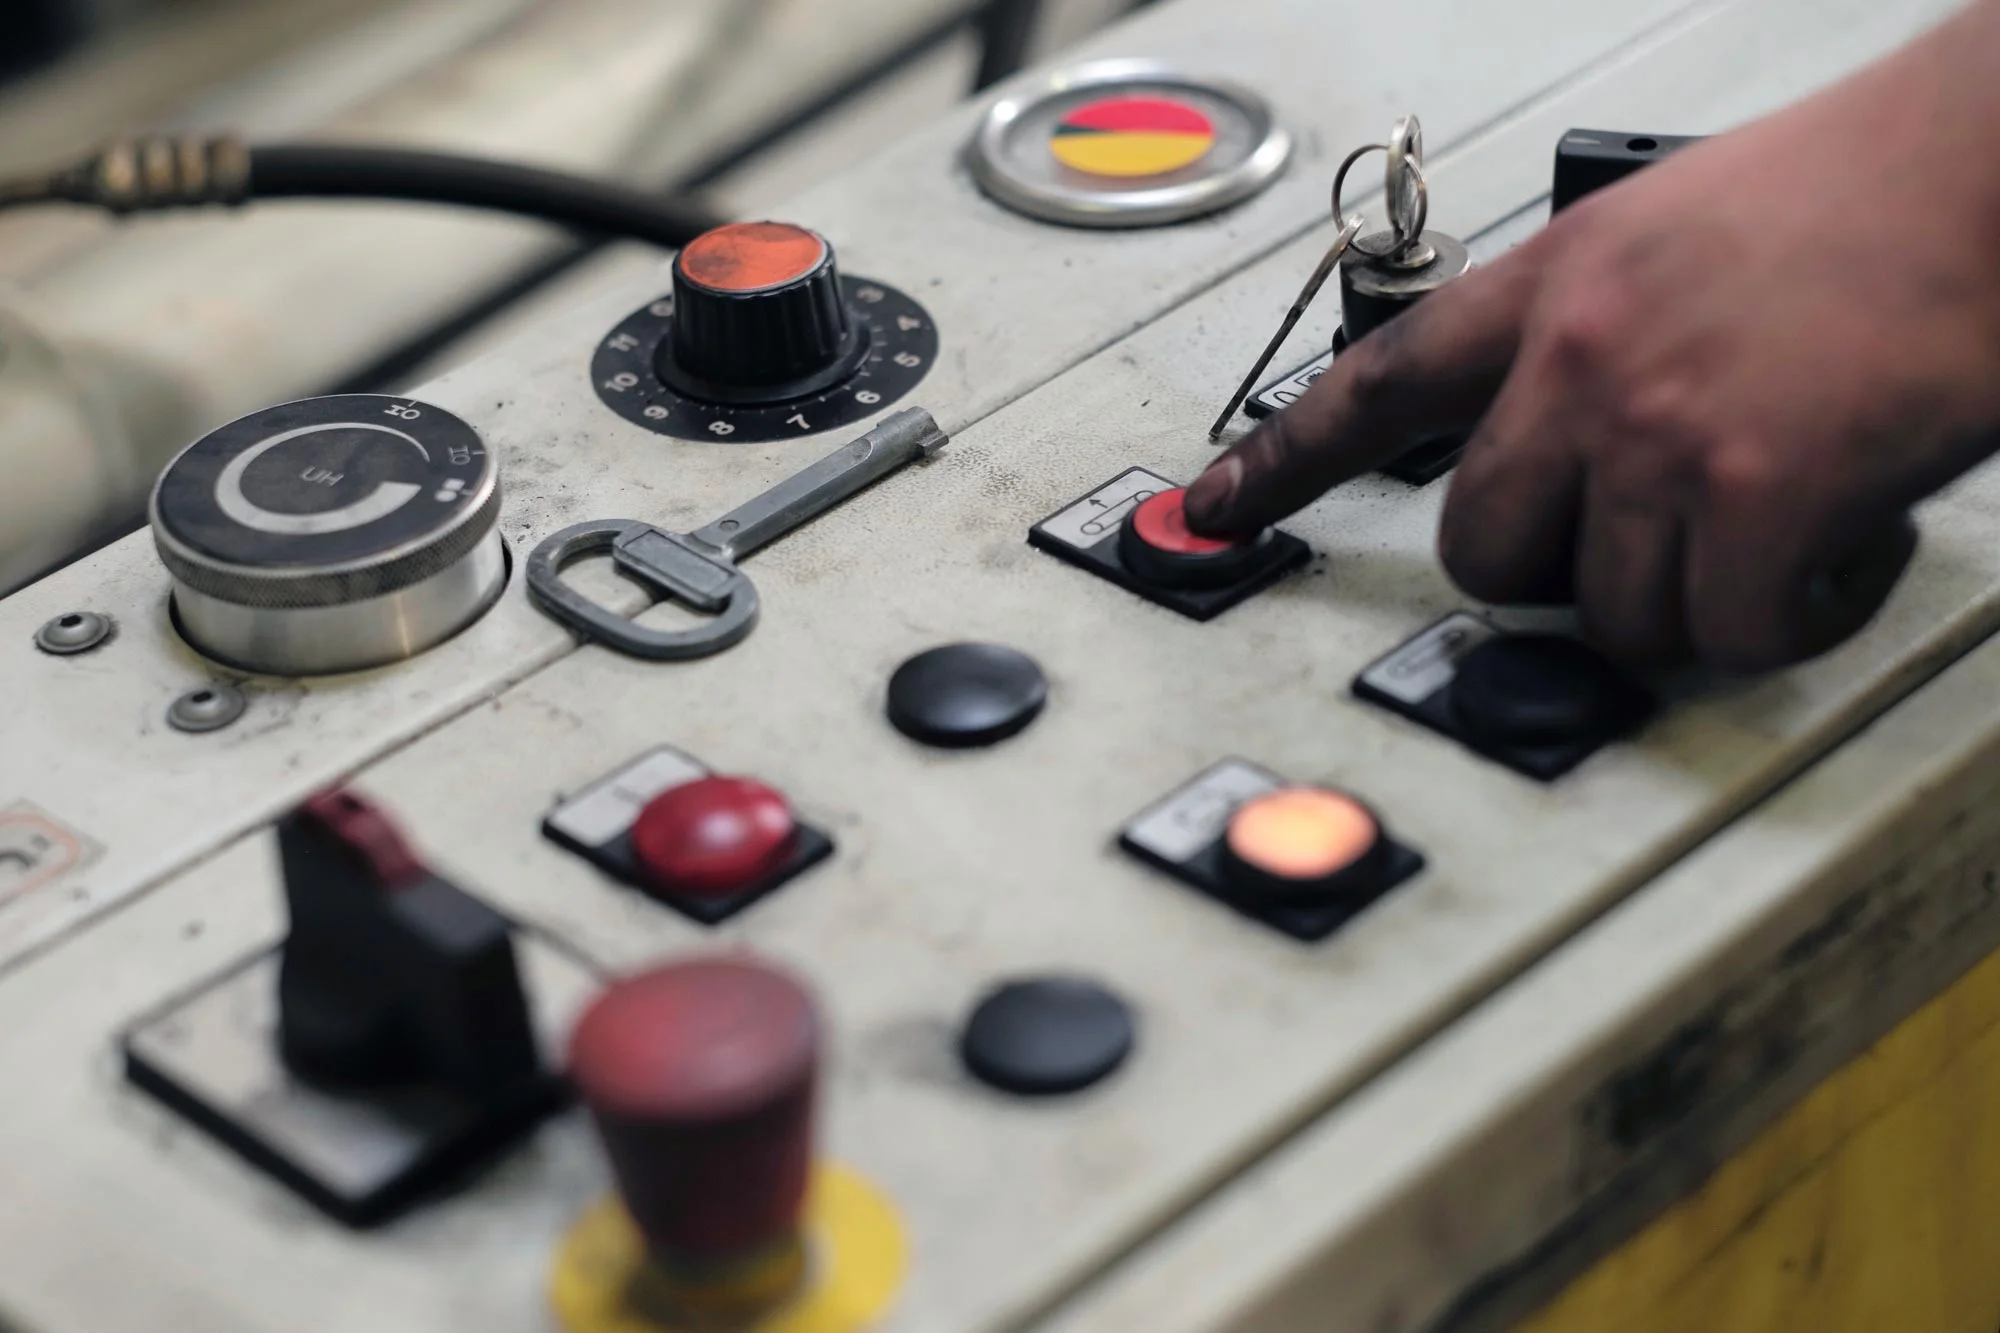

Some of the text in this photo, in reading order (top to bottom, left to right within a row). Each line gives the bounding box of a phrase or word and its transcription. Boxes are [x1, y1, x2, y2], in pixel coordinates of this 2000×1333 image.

[897, 314, 920, 331] 4
[608, 333, 639, 351] 11
[893, 352, 920, 367] 5
[604, 372, 639, 392] 10
[855, 390, 881, 404] 6
[643, 405, 669, 419] 9
[708, 421, 735, 435] 8
[786, 413, 811, 429] 7
